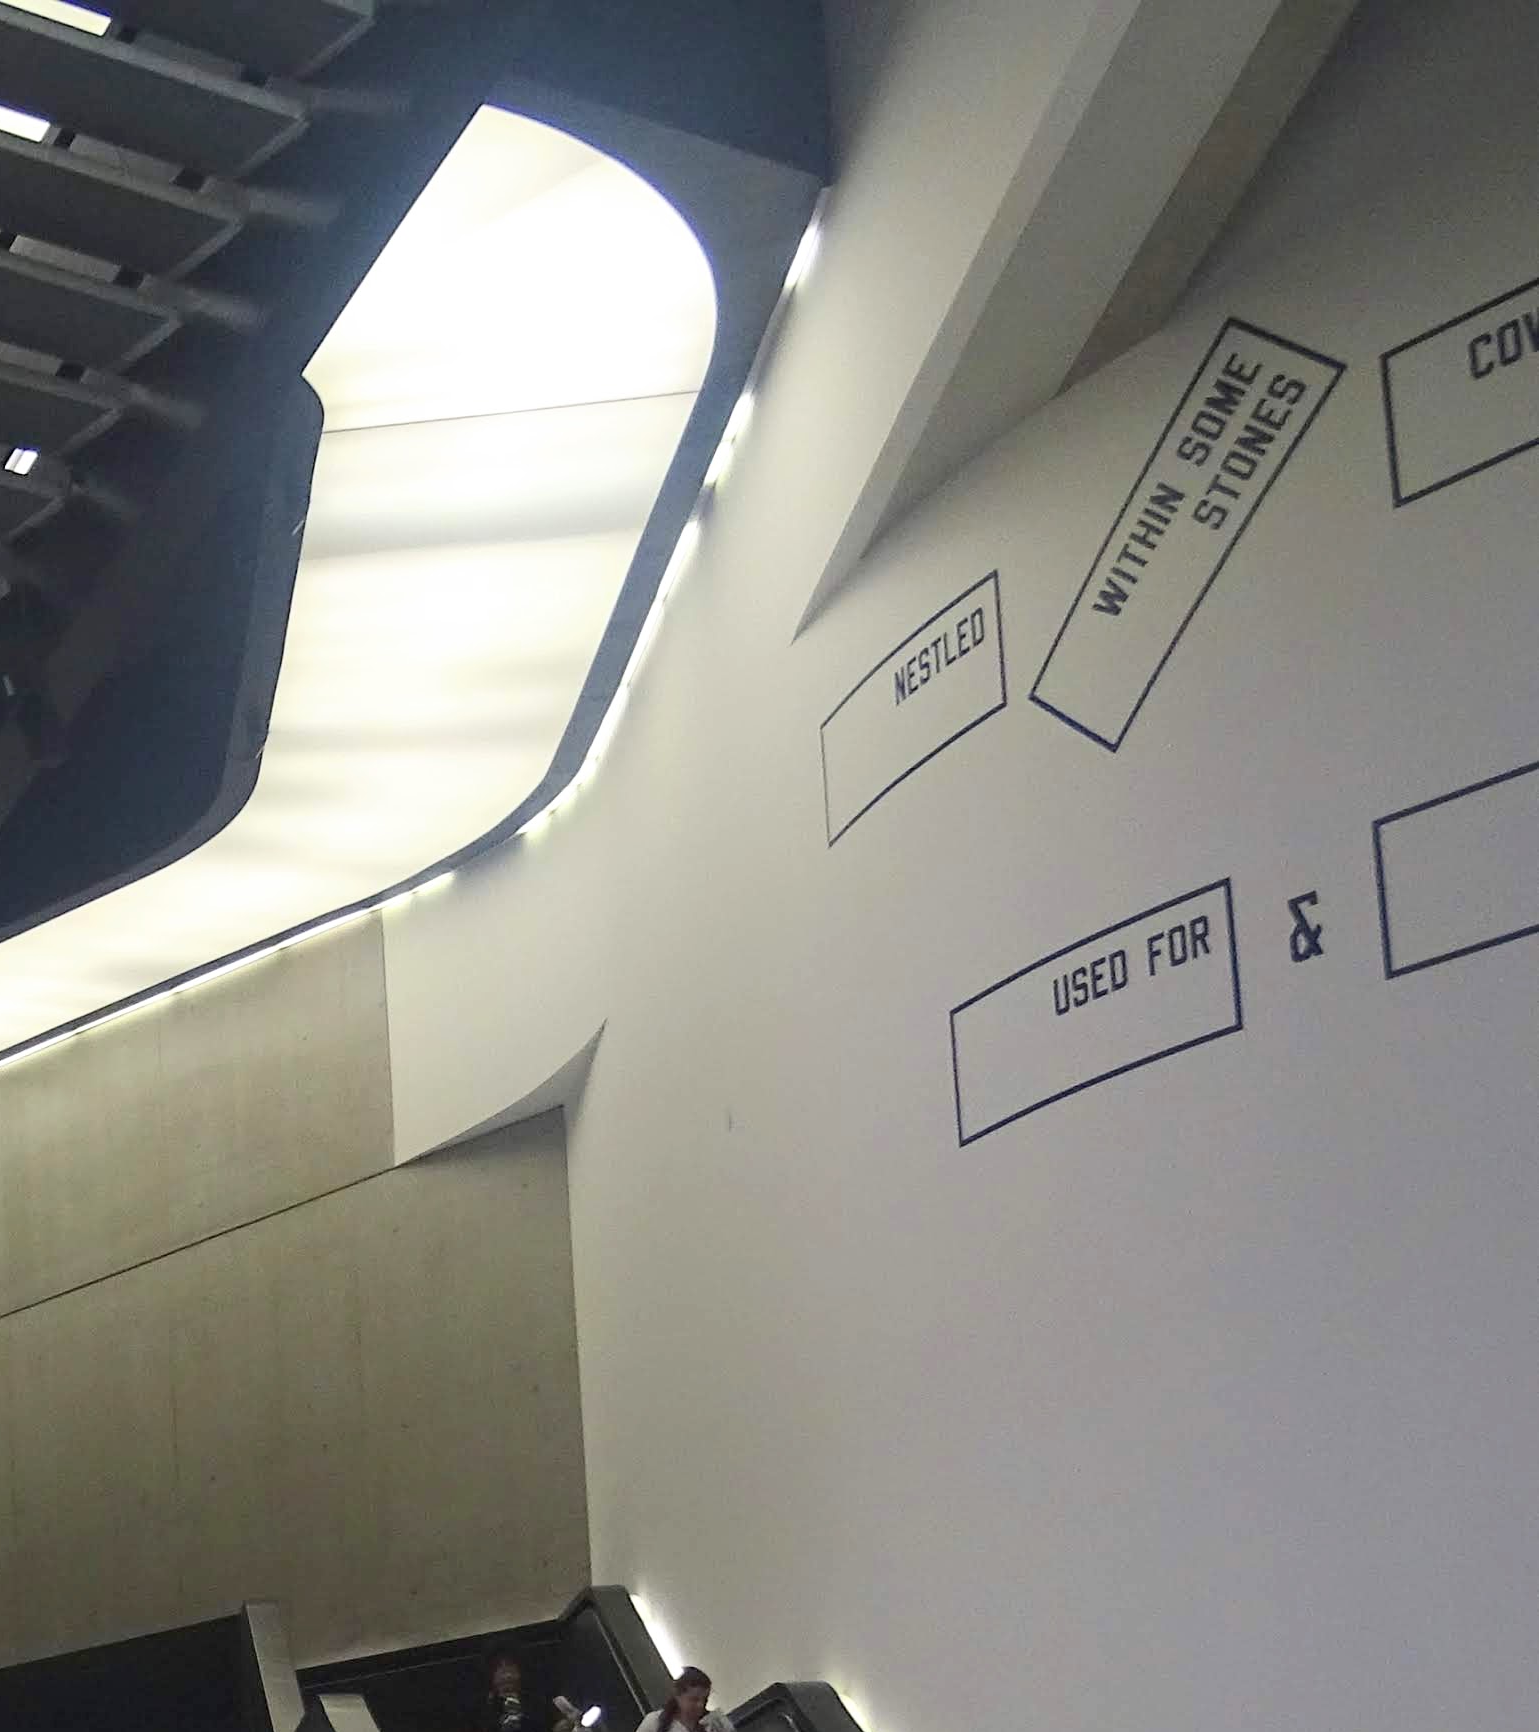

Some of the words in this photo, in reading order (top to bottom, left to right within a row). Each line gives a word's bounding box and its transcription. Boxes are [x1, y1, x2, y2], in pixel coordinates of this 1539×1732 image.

[1092, 483, 1186, 617] WITHIN
[1177, 352, 1263, 467] SOME
[1193, 373, 1307, 531] STONES
[893, 606, 986, 706] NESTLED
[1053, 949, 1129, 1016] USED
[1147, 915, 1211, 977] FOR
[1288, 891, 1324, 963] &
